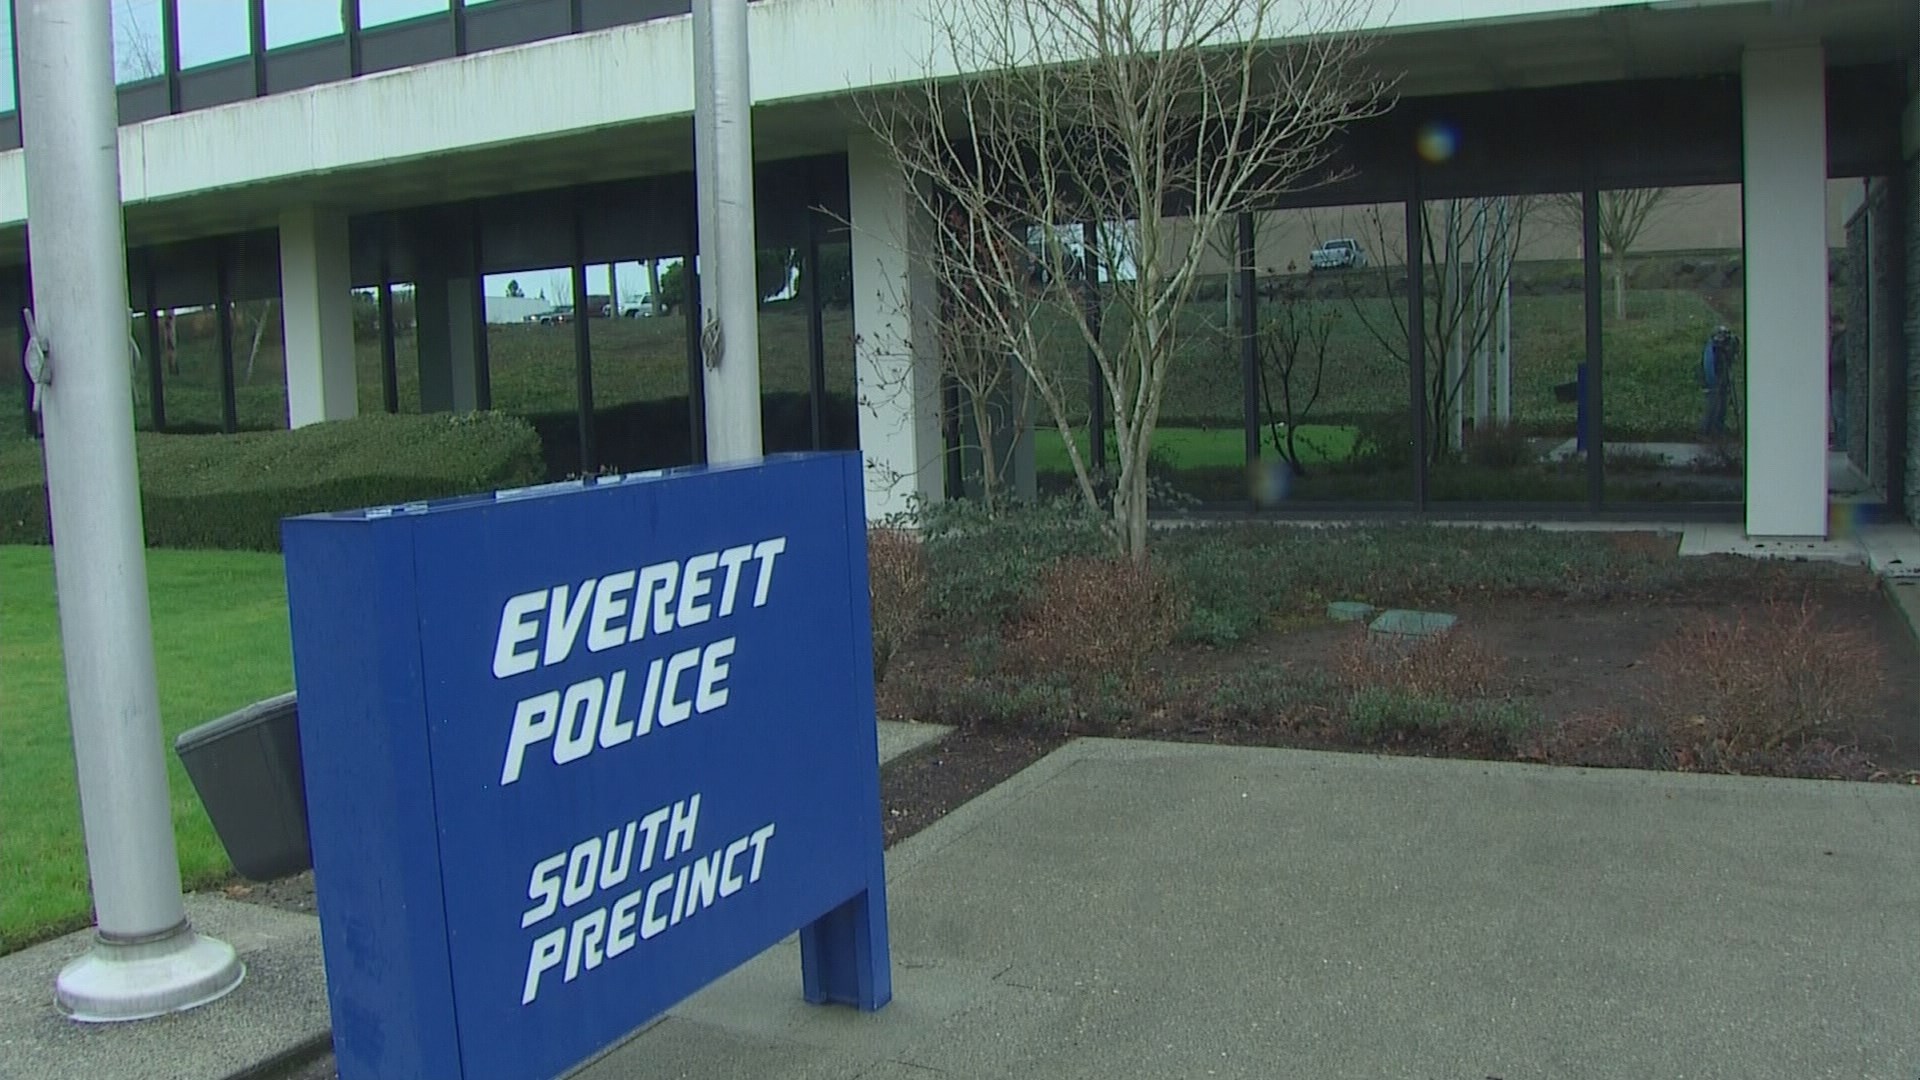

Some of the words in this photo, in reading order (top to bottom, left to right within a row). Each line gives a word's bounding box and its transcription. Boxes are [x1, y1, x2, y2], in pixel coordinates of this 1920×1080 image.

[493, 537, 786, 678] EVERETT
[501, 637, 736, 785] POLICE
[521, 793, 700, 928] SOUTH
[522, 823, 775, 1005] PRECINCT
